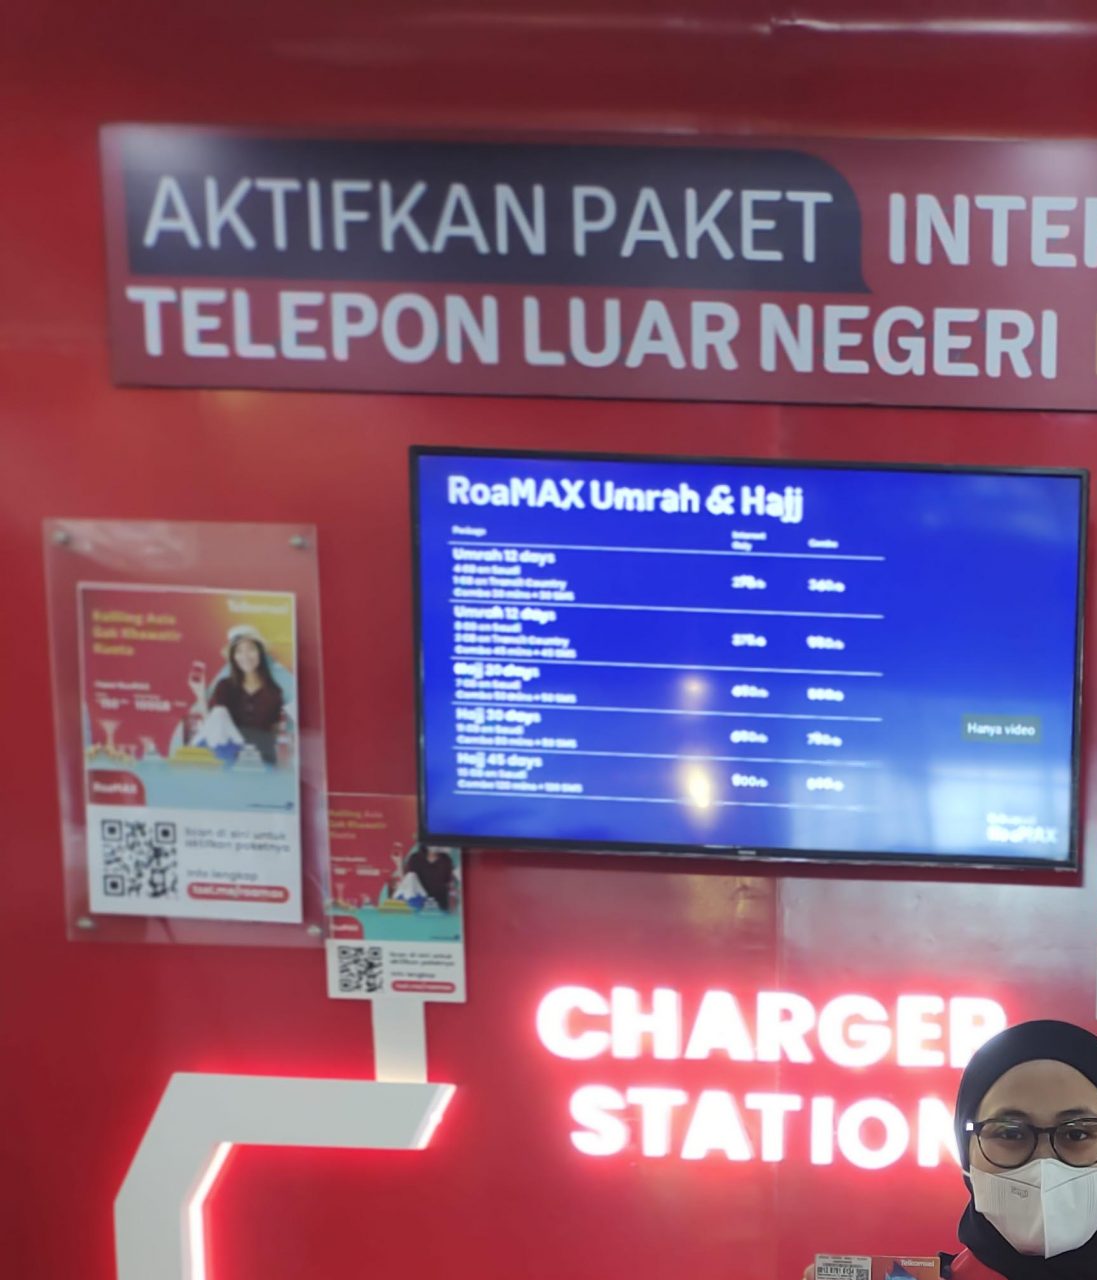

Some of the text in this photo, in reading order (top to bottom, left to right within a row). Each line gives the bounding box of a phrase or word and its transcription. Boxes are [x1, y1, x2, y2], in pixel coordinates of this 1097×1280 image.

[143, 176, 547, 255] AKTIFKAN
[572, 185, 833, 263] PAKET
[126, 287, 498, 366] TELEPON
[523, 297, 739, 370] LUAR
[760, 304, 1058, 379] NEGERI
[448, 475, 804, 523] RoaMAX Umrah & Hajj
[967, 722, 1036, 736] Hanya video
[536, 985, 1007, 1070] CHARGER
[900, 1259, 935, 1268] Telkomsel
